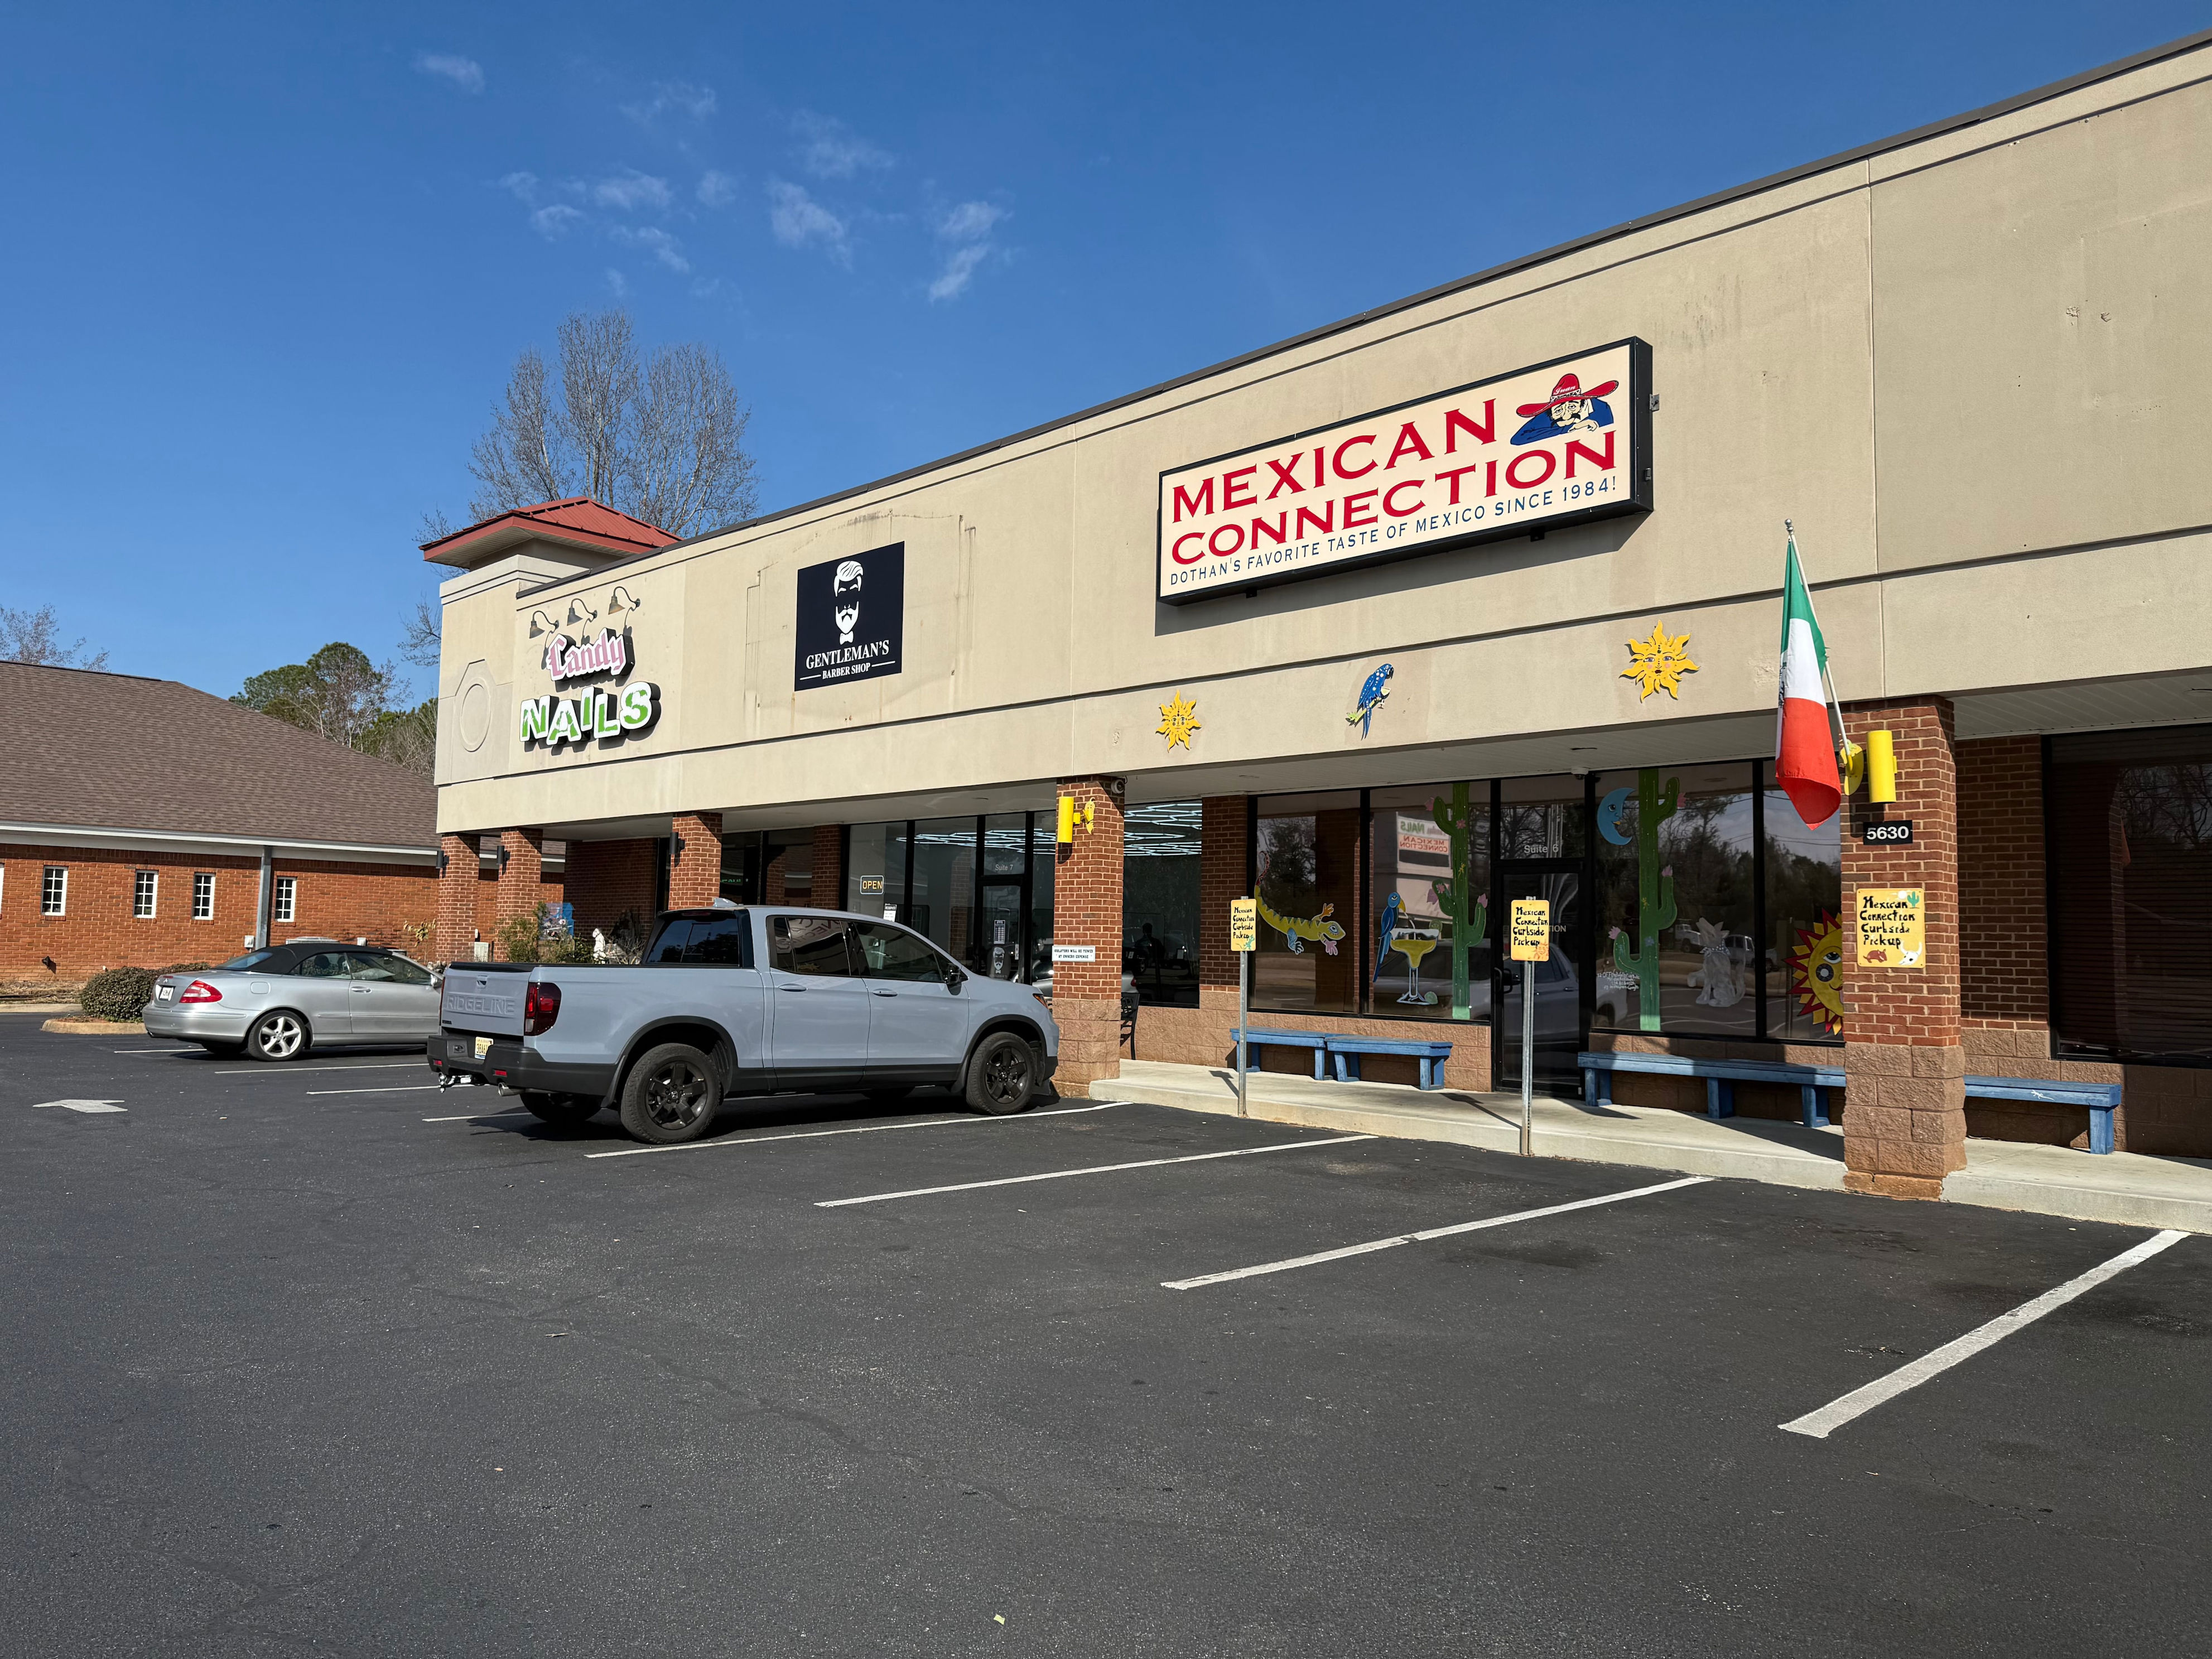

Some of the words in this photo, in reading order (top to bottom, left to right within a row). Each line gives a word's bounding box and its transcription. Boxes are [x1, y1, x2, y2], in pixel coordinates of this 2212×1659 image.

[1553, 385, 1576, 395] Juan
[1172, 398, 1497, 523] MEXICAN
[1172, 430, 1617, 565] CONNECTION
[1170, 557, 1240, 585] DOTHAN'S
[1247, 542, 1320, 570] FAVORITE
[1328, 529, 1378, 552] TASTE
[1387, 522, 1408, 539] OF
[1415, 505, 1485, 533] MEXICO
[1495, 490, 1553, 516] SINCE
[1563, 475, 1616, 501] 1984!
[546, 627, 626, 681] Candy
[806, 639, 889, 669] GENTLEMAN'S
[822, 667, 850, 679] BARBER
[851, 662, 871, 674] SHOP
[519, 681, 652, 745] NAILS
[1866, 826, 1909, 840] 5630
[1524, 844, 1548, 853] Suite
[1553, 843, 1559, 853] 6
[862, 880, 883, 889] OPEN
[1862, 896, 1908, 909] Mexican
[1515, 906, 1545, 916] Mexican
[1859, 909, 1915, 921] Connection
[1515, 917, 1548, 925] Connection
[1861, 922, 1910, 933] Curbside
[1513, 925, 1545, 936] Curbside
[1514, 936, 1540, 947] Pickup
[1863, 934, 1901, 949] Pickup
[447, 995, 515, 1015] RIDGELINE
